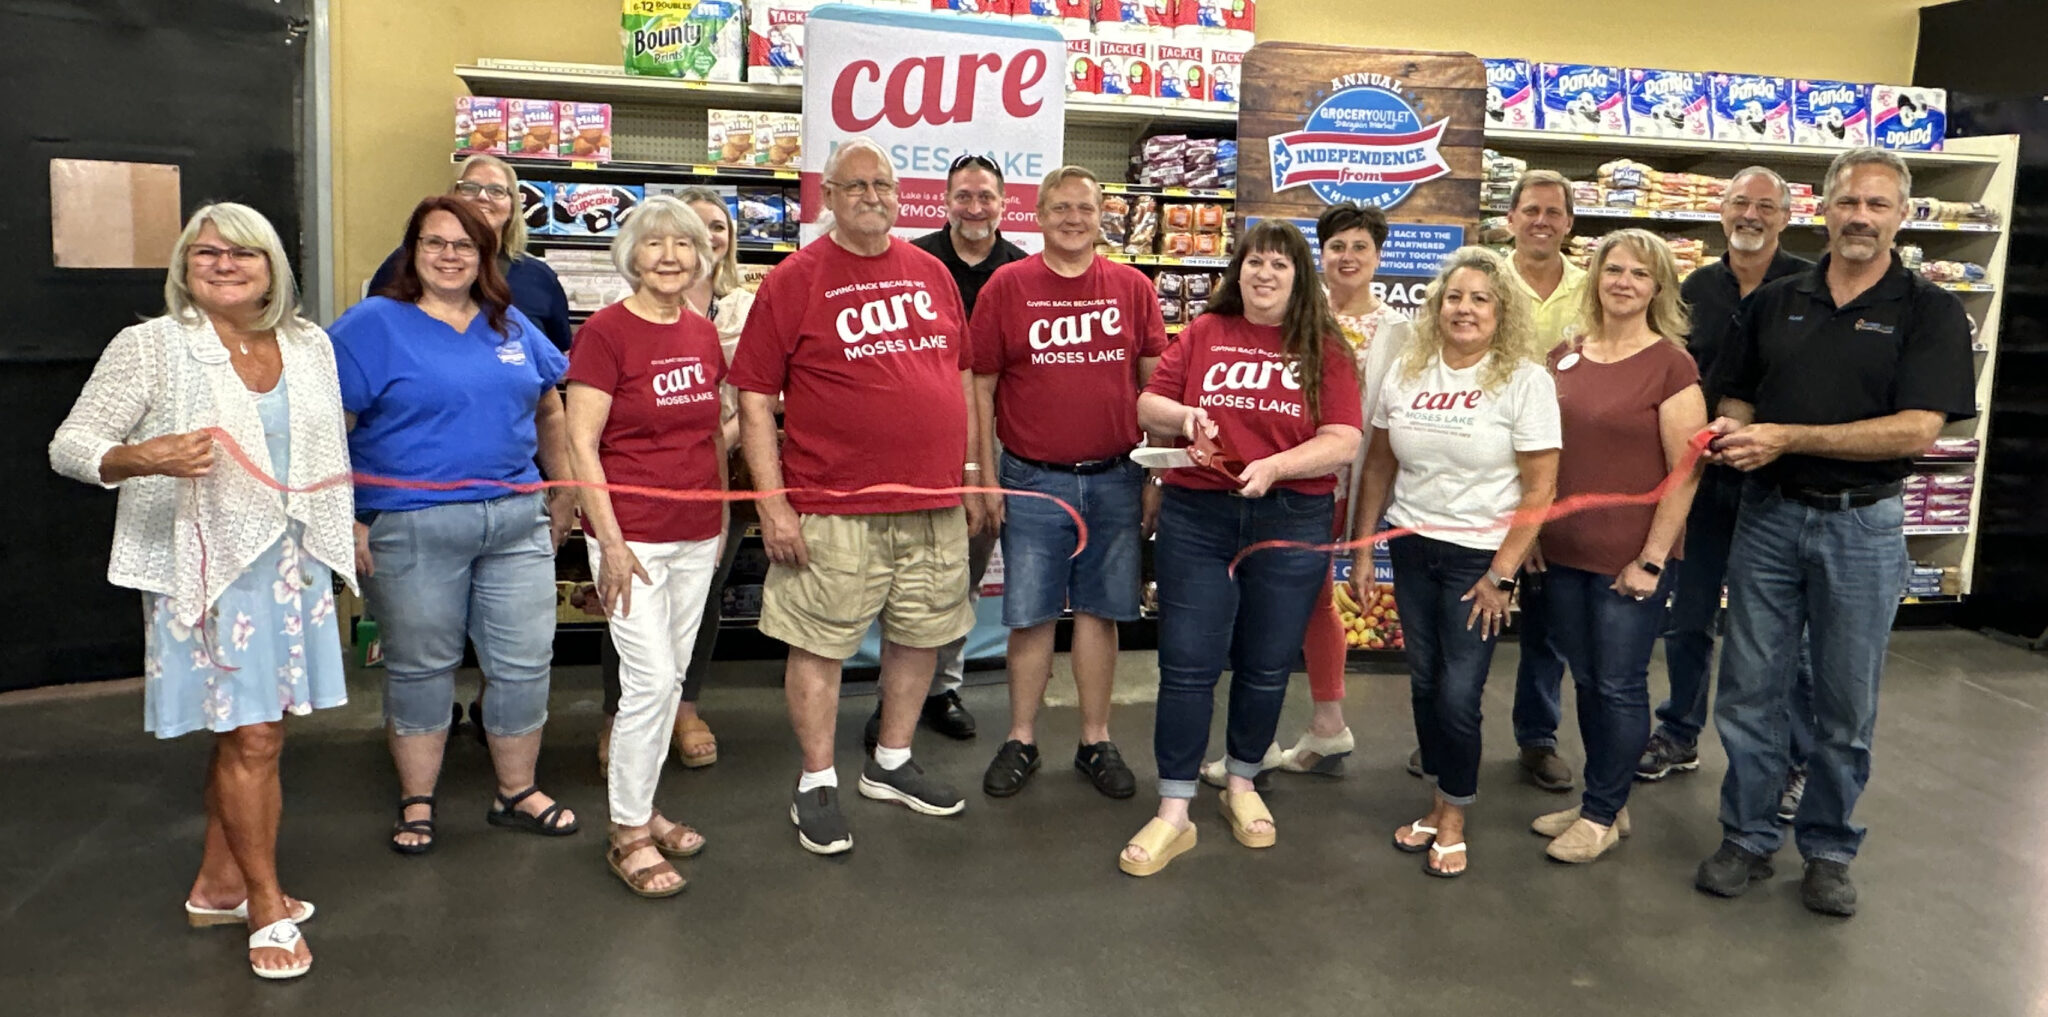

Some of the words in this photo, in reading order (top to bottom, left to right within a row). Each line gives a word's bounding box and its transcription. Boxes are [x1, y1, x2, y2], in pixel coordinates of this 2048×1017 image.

[771, 10, 806, 24] TACK
[634, 23, 702, 57] Bounty
[1102, 43, 1145, 57] TACKLE
[654, 51, 684, 65] Prints
[1161, 47, 1201, 60] TACKLE
[1214, 51, 1244, 63] TACK
[831, 48, 1047, 133] care
[1330, 72, 1404, 94] ANNUAL
[1559, 69, 1607, 97] panda
[1645, 73, 1693, 101] panda
[1729, 77, 1775, 105] panda
[1809, 85, 1855, 112] panda
[1886, 122, 1933, 150] panda
[1297, 147, 1427, 167] INDEPENDENCE
[1339, 167, 1381, 185] from
[568, 197, 618, 216] Cupcakes
[1394, 230, 1417, 238] BACK
[1419, 231, 1432, 239] TO
[1434, 231, 1451, 240] THE
[1394, 241, 1446, 250] PARTNERED
[824, 284, 856, 299] GIVING
[856, 282, 879, 292] BACK
[1074, 299, 1105, 307] BECAUSE
[836, 290, 938, 344] care
[1028, 307, 1122, 350] care
[844, 339, 907, 362] MOSES
[909, 335, 948, 351] LAKE
[1031, 352, 1085, 365] MOSES
[1088, 348, 1126, 363] LAKE
[652, 362, 706, 397] care
[656, 394, 691, 407] MOSES
[690, 391, 715, 403] LAKE
[1199, 393, 1256, 410] MOSES
[1258, 398, 1302, 418] LAKE
[1411, 389, 1483, 411] care
[1405, 411, 1443, 423] MOSES
[1444, 415, 1476, 427] LAKE
